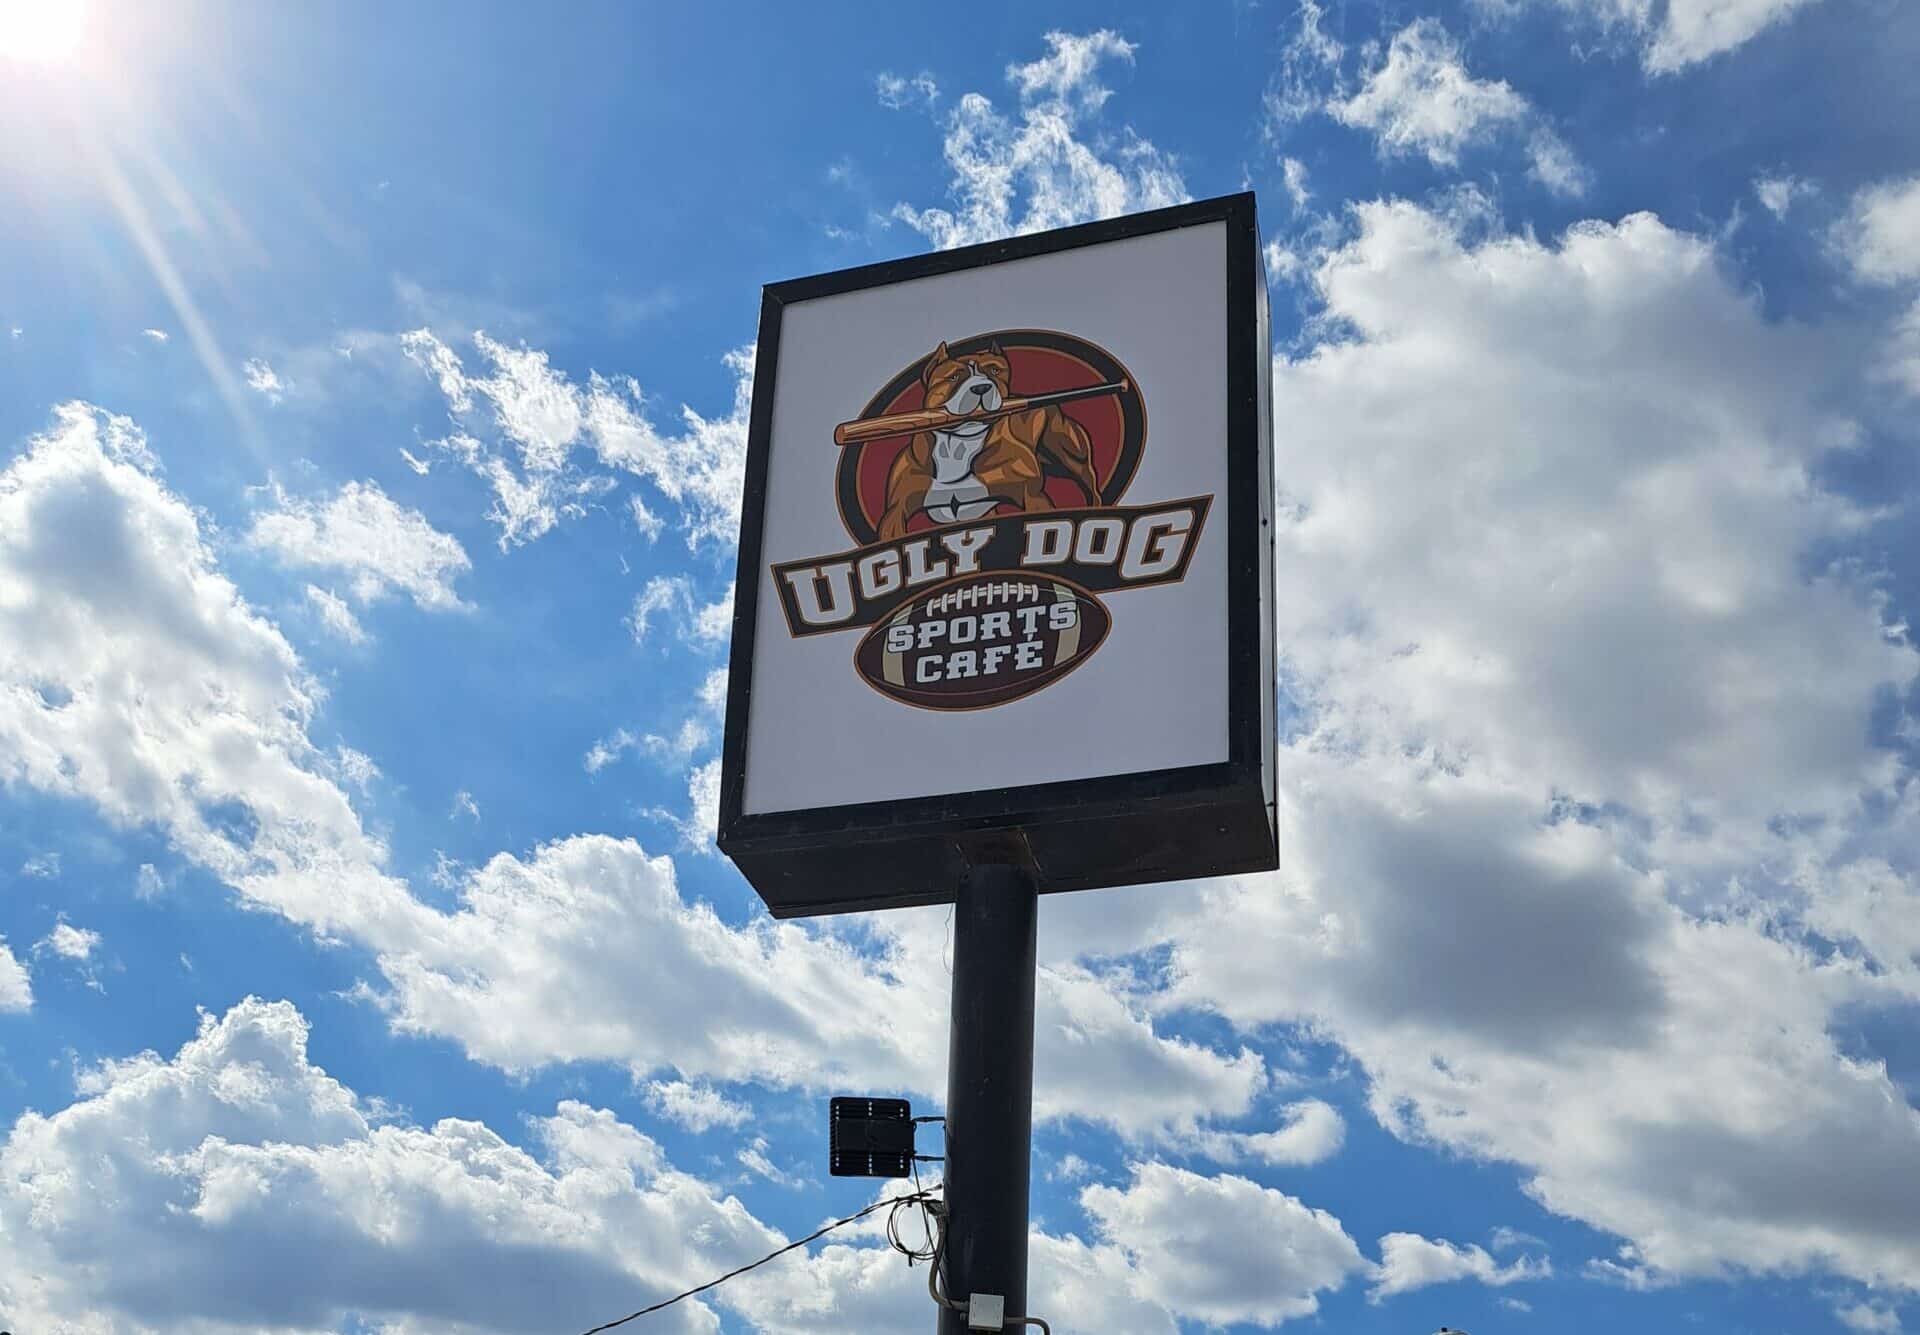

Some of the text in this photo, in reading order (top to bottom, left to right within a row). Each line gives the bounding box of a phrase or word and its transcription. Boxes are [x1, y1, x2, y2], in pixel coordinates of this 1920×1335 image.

[785, 509, 1197, 625] UGLY DOG
[887, 601, 1078, 653] SPORTS
[915, 632, 1044, 684] CAFÉ
